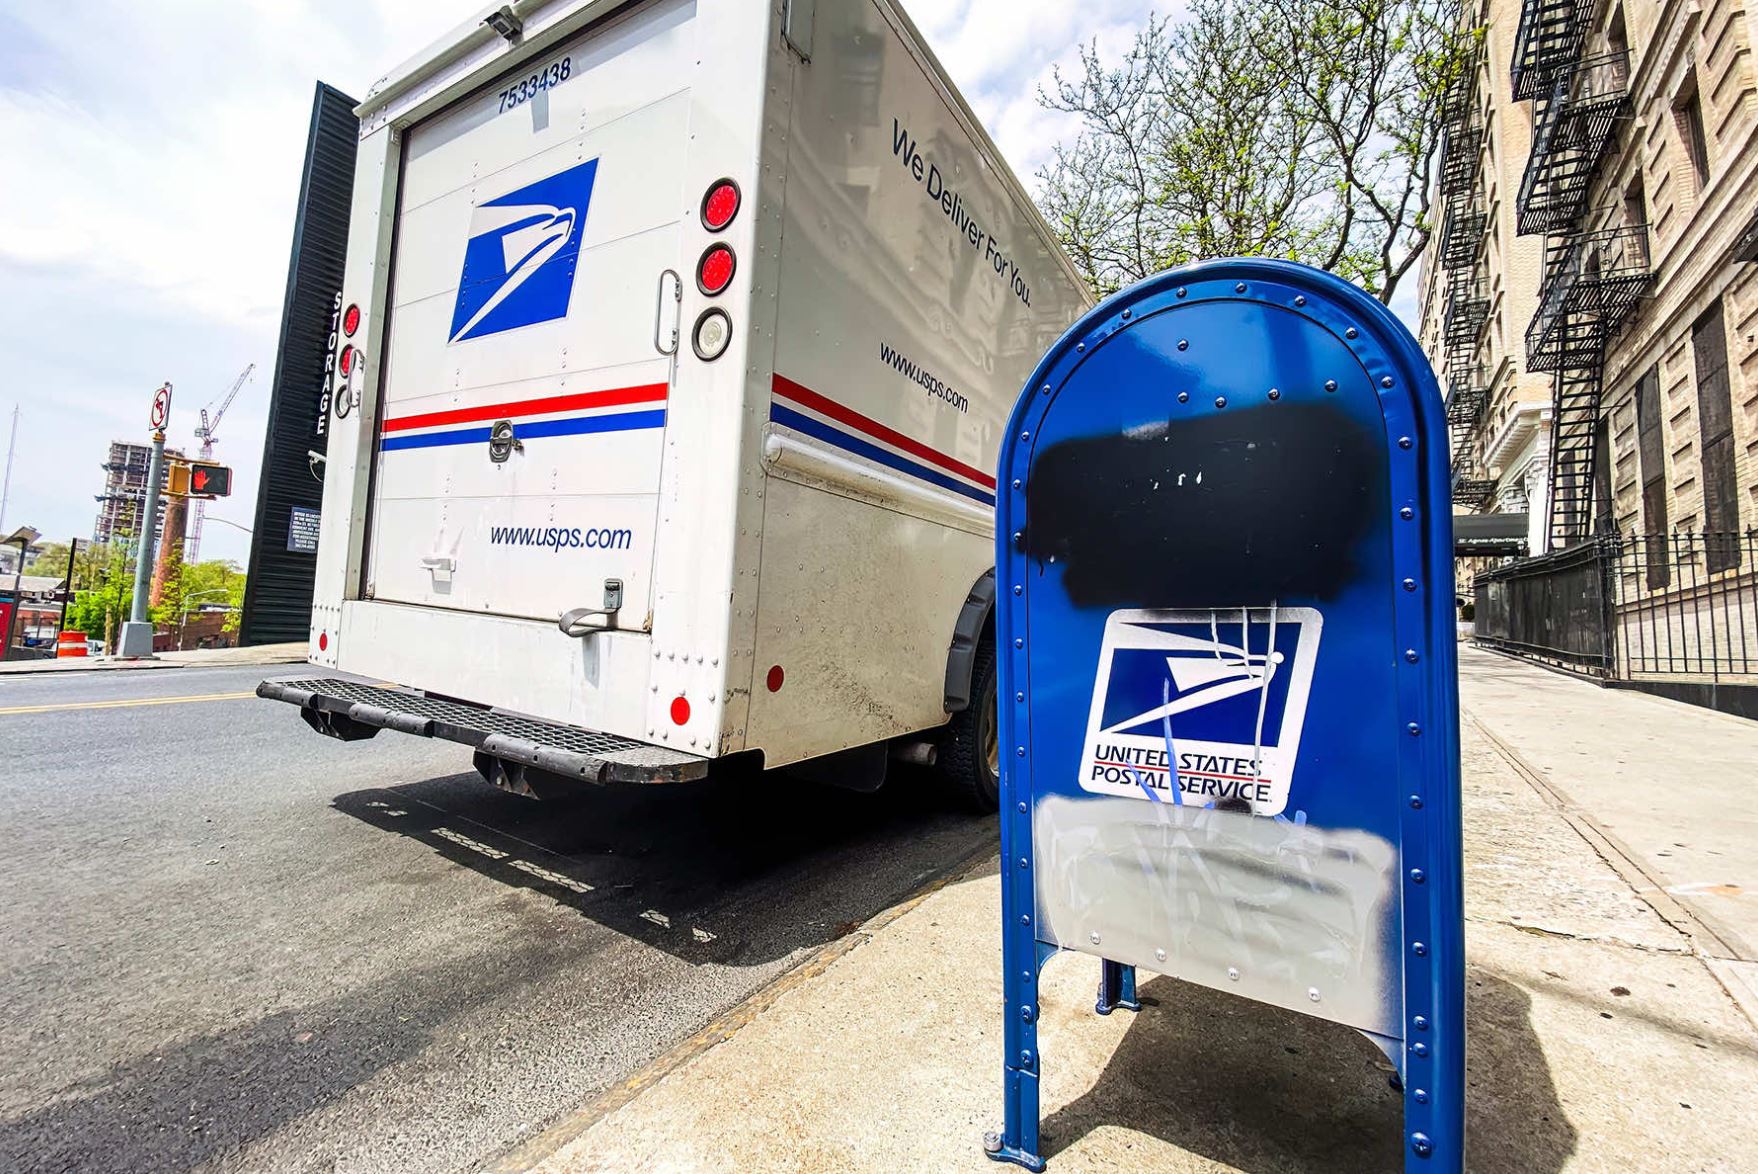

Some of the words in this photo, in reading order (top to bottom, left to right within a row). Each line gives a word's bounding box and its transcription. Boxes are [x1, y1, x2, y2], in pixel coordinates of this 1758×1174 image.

[498, 57, 571, 114] 7533438
[892, 117, 925, 182] We
[926, 163, 985, 250] Deliver
[985, 234, 1009, 278] For
[1009, 260, 1031, 308] You.
[316, 291, 342, 435] STORAGE
[880, 342, 969, 414] www.usps.com
[490, 526, 632, 554] www.usps.com
[1091, 765, 1170, 790] POSTAL
[1094, 744, 1170, 768] UNITED
[1178, 752, 1263, 777] STATES
